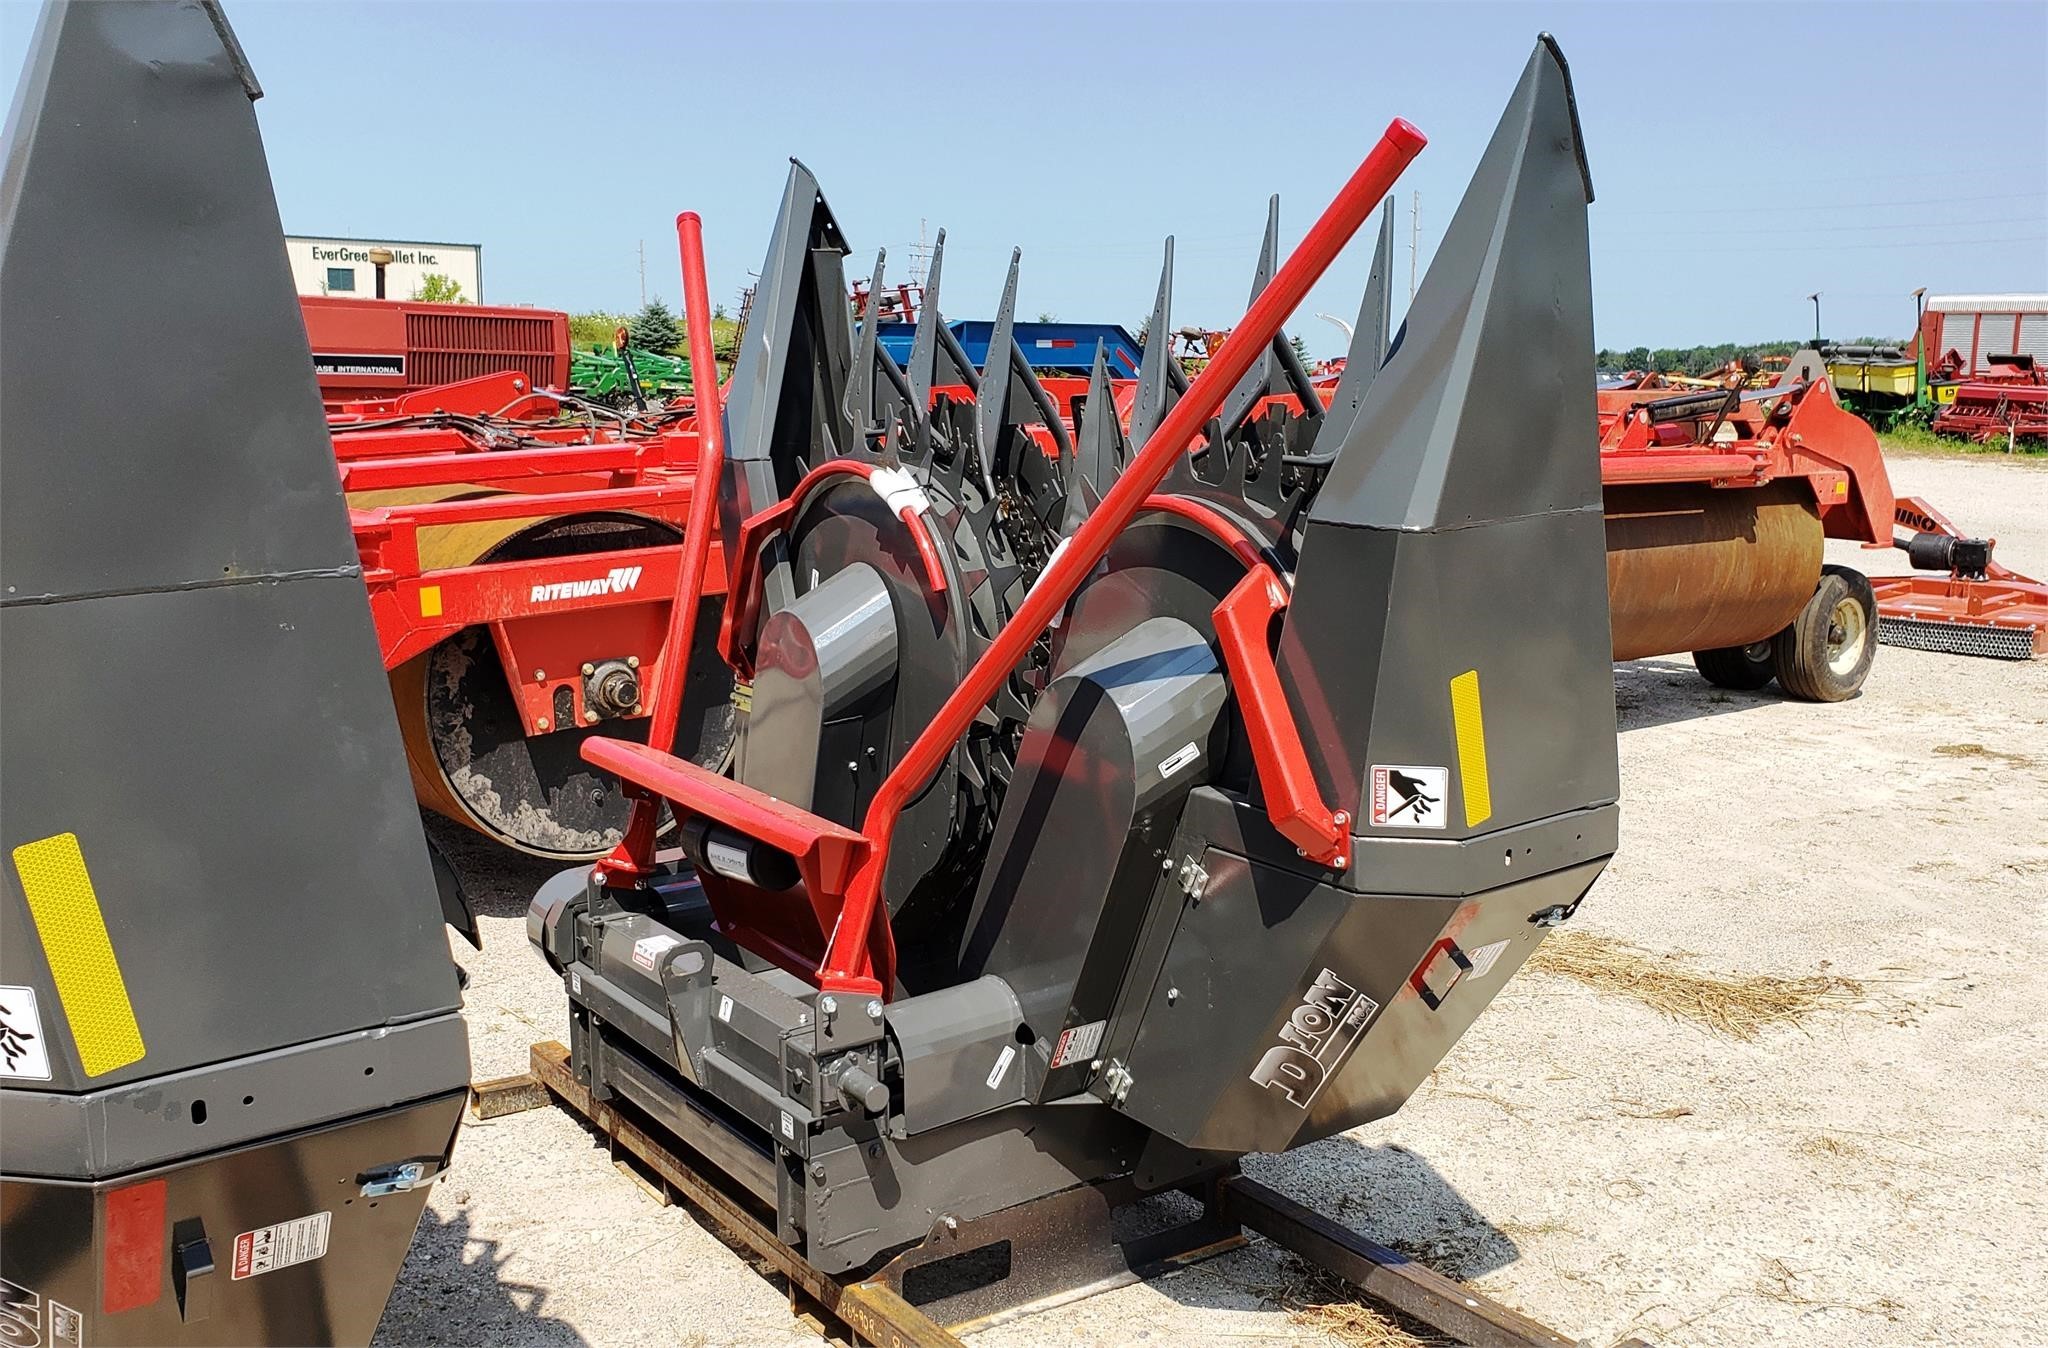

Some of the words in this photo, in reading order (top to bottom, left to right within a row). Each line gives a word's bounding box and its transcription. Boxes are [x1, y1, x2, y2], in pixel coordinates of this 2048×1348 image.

[312, 246, 369, 261] EverGree
[418, 251, 439, 265] Inc.
[337, 365, 399, 374] INTERNATIONAL
[530, 578, 612, 603] RITEWAY
[1375, 772, 1386, 810] DANGER
[1249, 967, 1357, 1110] DION
[238, 1238, 250, 1267] DANGER
